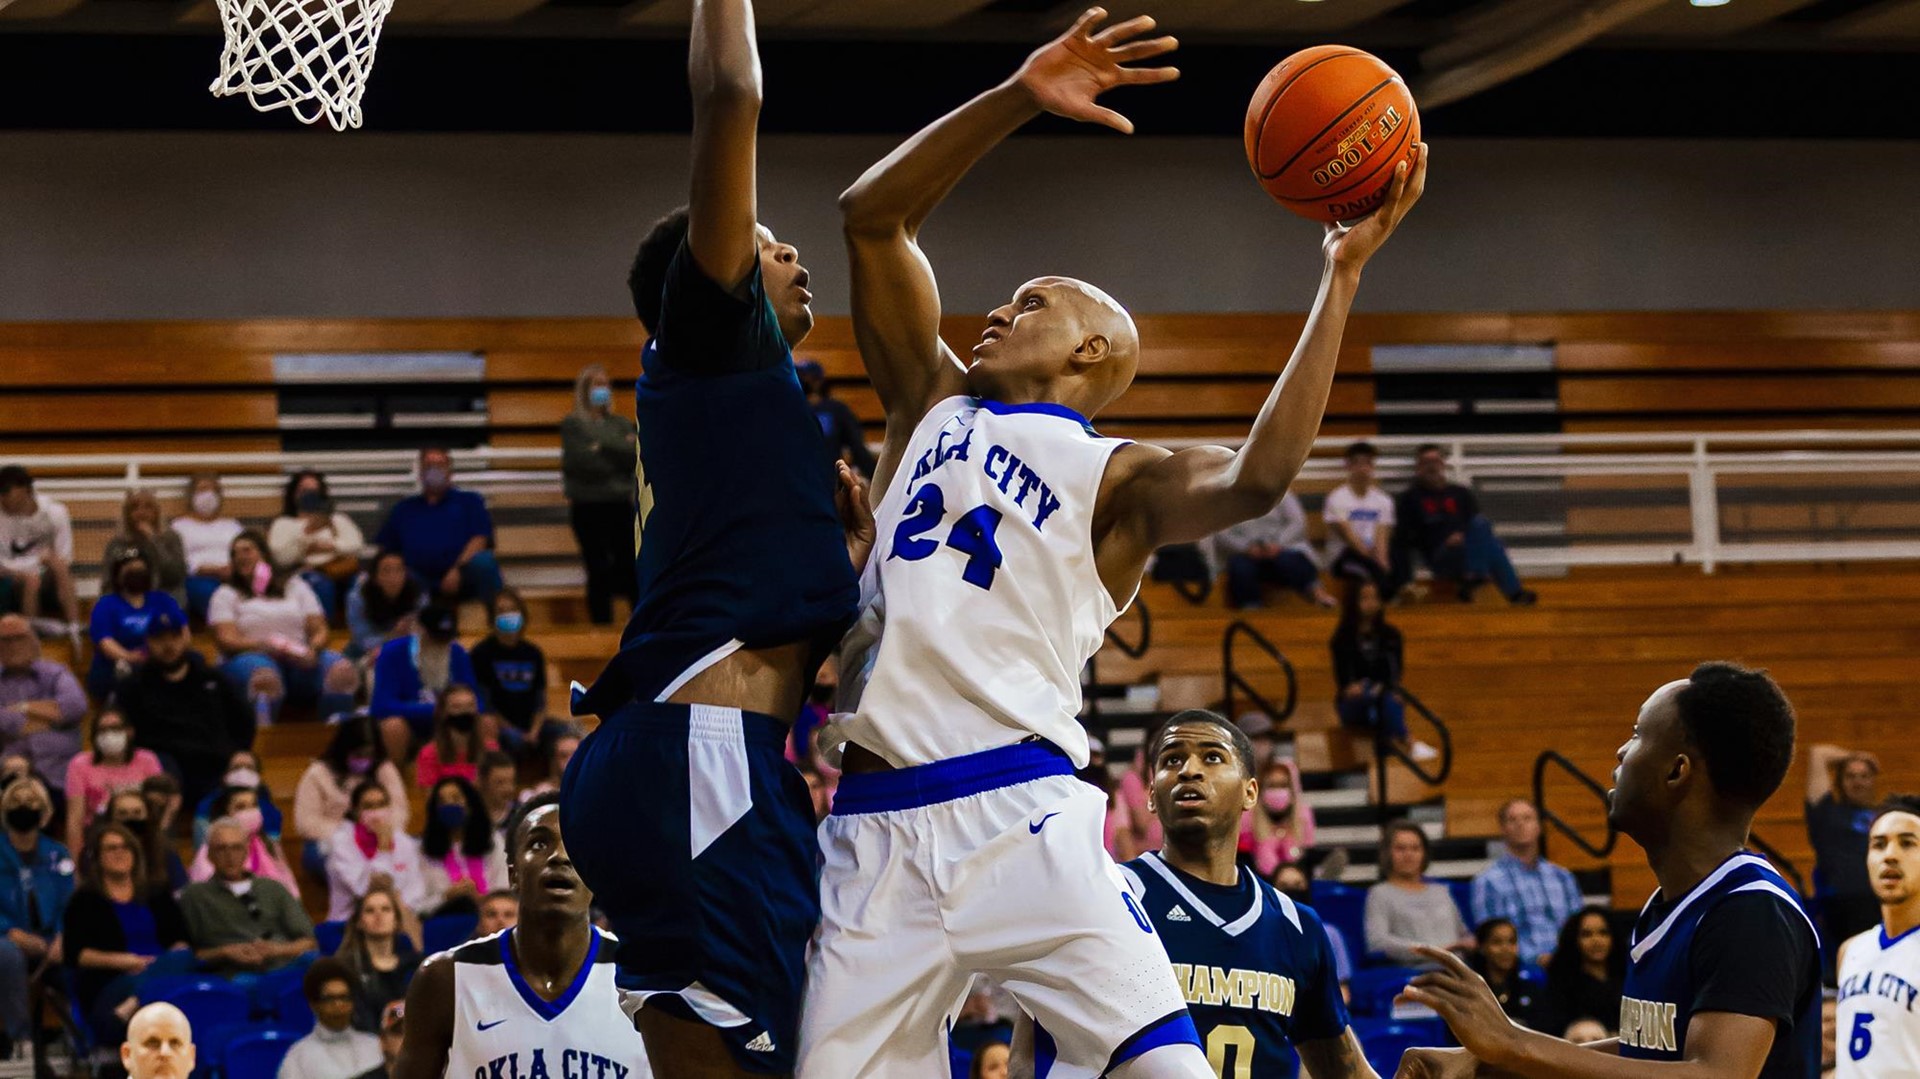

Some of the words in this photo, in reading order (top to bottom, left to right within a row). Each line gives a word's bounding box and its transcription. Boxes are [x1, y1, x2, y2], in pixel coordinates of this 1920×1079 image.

[1312, 105, 1402, 187] TF-1000
[1338, 121, 1371, 153] LEGACY
[906, 428, 975, 495] KLA
[983, 444, 1061, 533] CITY
[886, 483, 1003, 591] 24
[1171, 963, 1296, 1017] HAMPION
[1877, 972, 1919, 1013] CITY
[1848, 1012, 1876, 1062] 5
[562, 1048, 629, 1079] CITY
